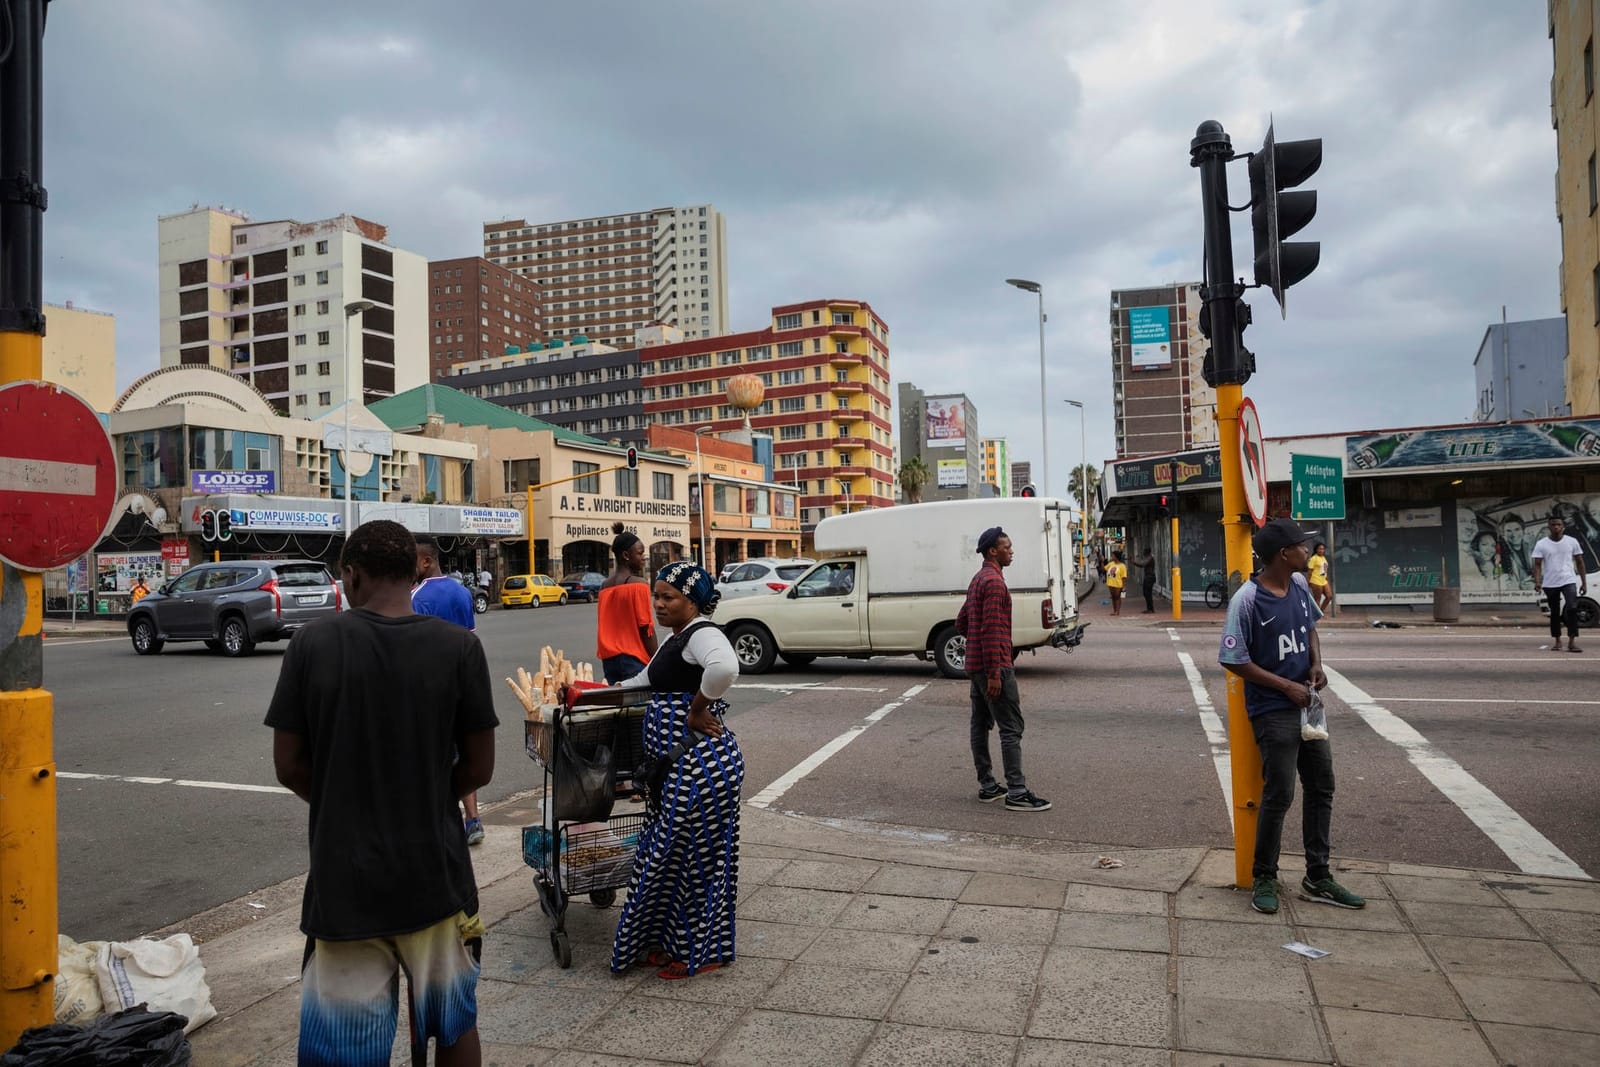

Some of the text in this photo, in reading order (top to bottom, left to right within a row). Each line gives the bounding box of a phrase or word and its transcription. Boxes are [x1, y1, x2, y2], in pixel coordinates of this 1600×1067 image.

[1449, 440, 1497, 456] LITE
[1155, 464, 1182, 482] LIQUR
[1305, 464, 1336, 479] Addington
[198, 474, 269, 484] LODGE
[1120, 470, 1150, 488] LITE
[1309, 483, 1336, 494] Southern
[593, 498, 632, 514] WRIGHT
[635, 502, 686, 516] FURNISHERS
[1309, 498, 1334, 510] Beaches
[249, 510, 328, 522] COMPUWISE-DOC
[566, 524, 609, 538] Appliances
[652, 527, 682, 538] Antiques
[1393, 572, 1441, 588] LITE
